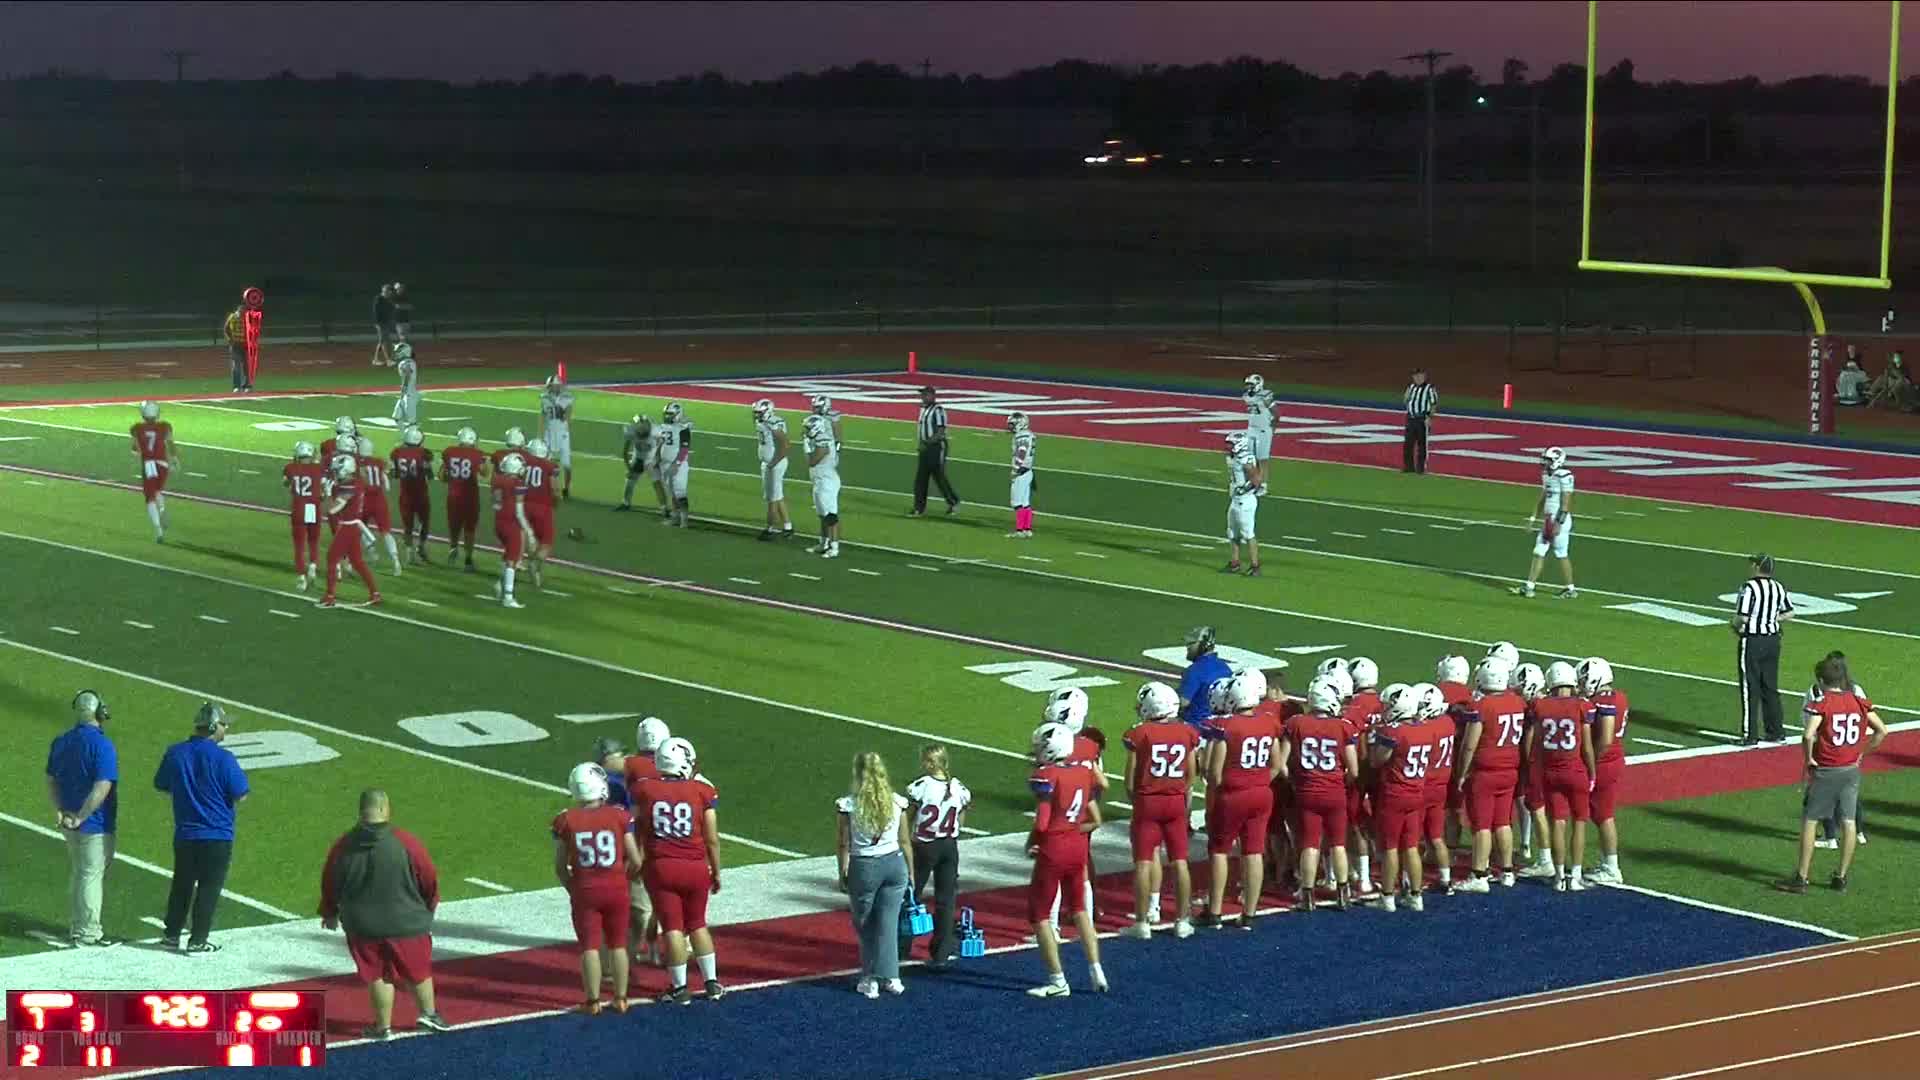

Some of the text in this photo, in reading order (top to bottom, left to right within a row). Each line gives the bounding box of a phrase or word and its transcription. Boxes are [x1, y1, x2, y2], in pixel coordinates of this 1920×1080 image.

[1810, 337, 1821, 432] CARDINALS
[144, 431, 156, 451] 7
[367, 464, 380, 486] 11
[449, 457, 472, 479] 58
[293, 475, 313, 496] 12
[1497, 713, 1524, 747] 75
[1542, 718, 1576, 750] 23
[1832, 713, 1861, 746] 56
[1151, 743, 1186, 778] 52
[1240, 735, 1272, 769] 66
[1300, 737, 1338, 770] 65
[1403, 745, 1432, 778] 55
[652, 800, 693, 838] 68
[915, 805, 957, 838] 24
[1065, 788, 1083, 823] 4
[575, 829, 617, 867] 59
